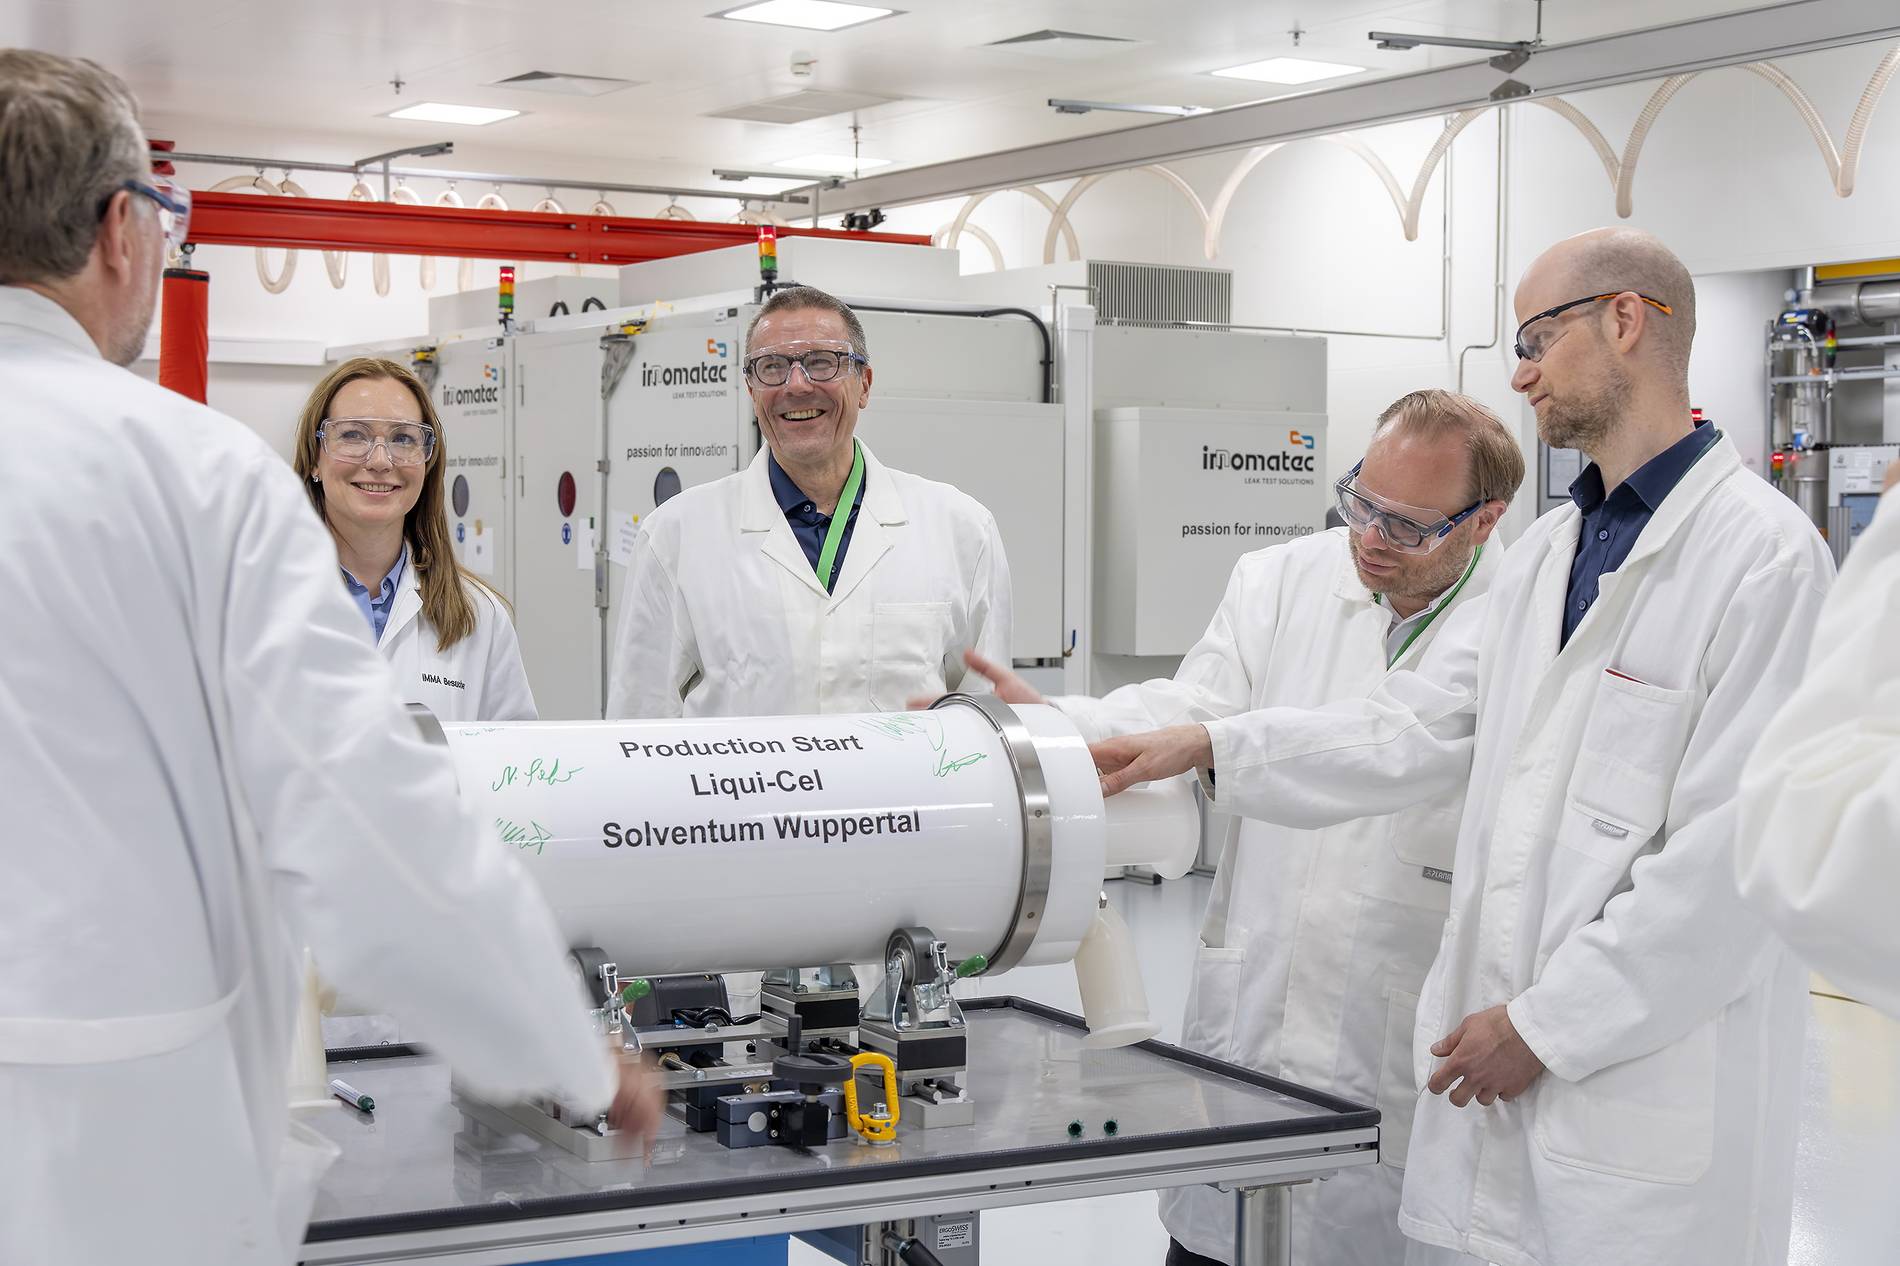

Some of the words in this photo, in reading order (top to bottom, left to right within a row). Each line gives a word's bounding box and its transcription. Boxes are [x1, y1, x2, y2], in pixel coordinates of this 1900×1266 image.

[626, 444, 662, 461] passion
[664, 443, 678, 457] for
[680, 442, 728, 457] innovation
[1244, 477, 1260, 485] LEAK
[1262, 477, 1277, 485] TEST
[1278, 477, 1314, 485] SOLUTIONS
[1182, 522, 1230, 538] passion
[1234, 522, 1251, 536] for
[1255, 522, 1314, 536] innovation
[421, 673, 442, 684] IMMA
[619, 738, 786, 758] Production
[791, 735, 864, 751] Start
[690, 769, 824, 800] Liqui-Cel
[602, 819, 765, 848] Solventum
[772, 807, 922, 844] Wuppertal
